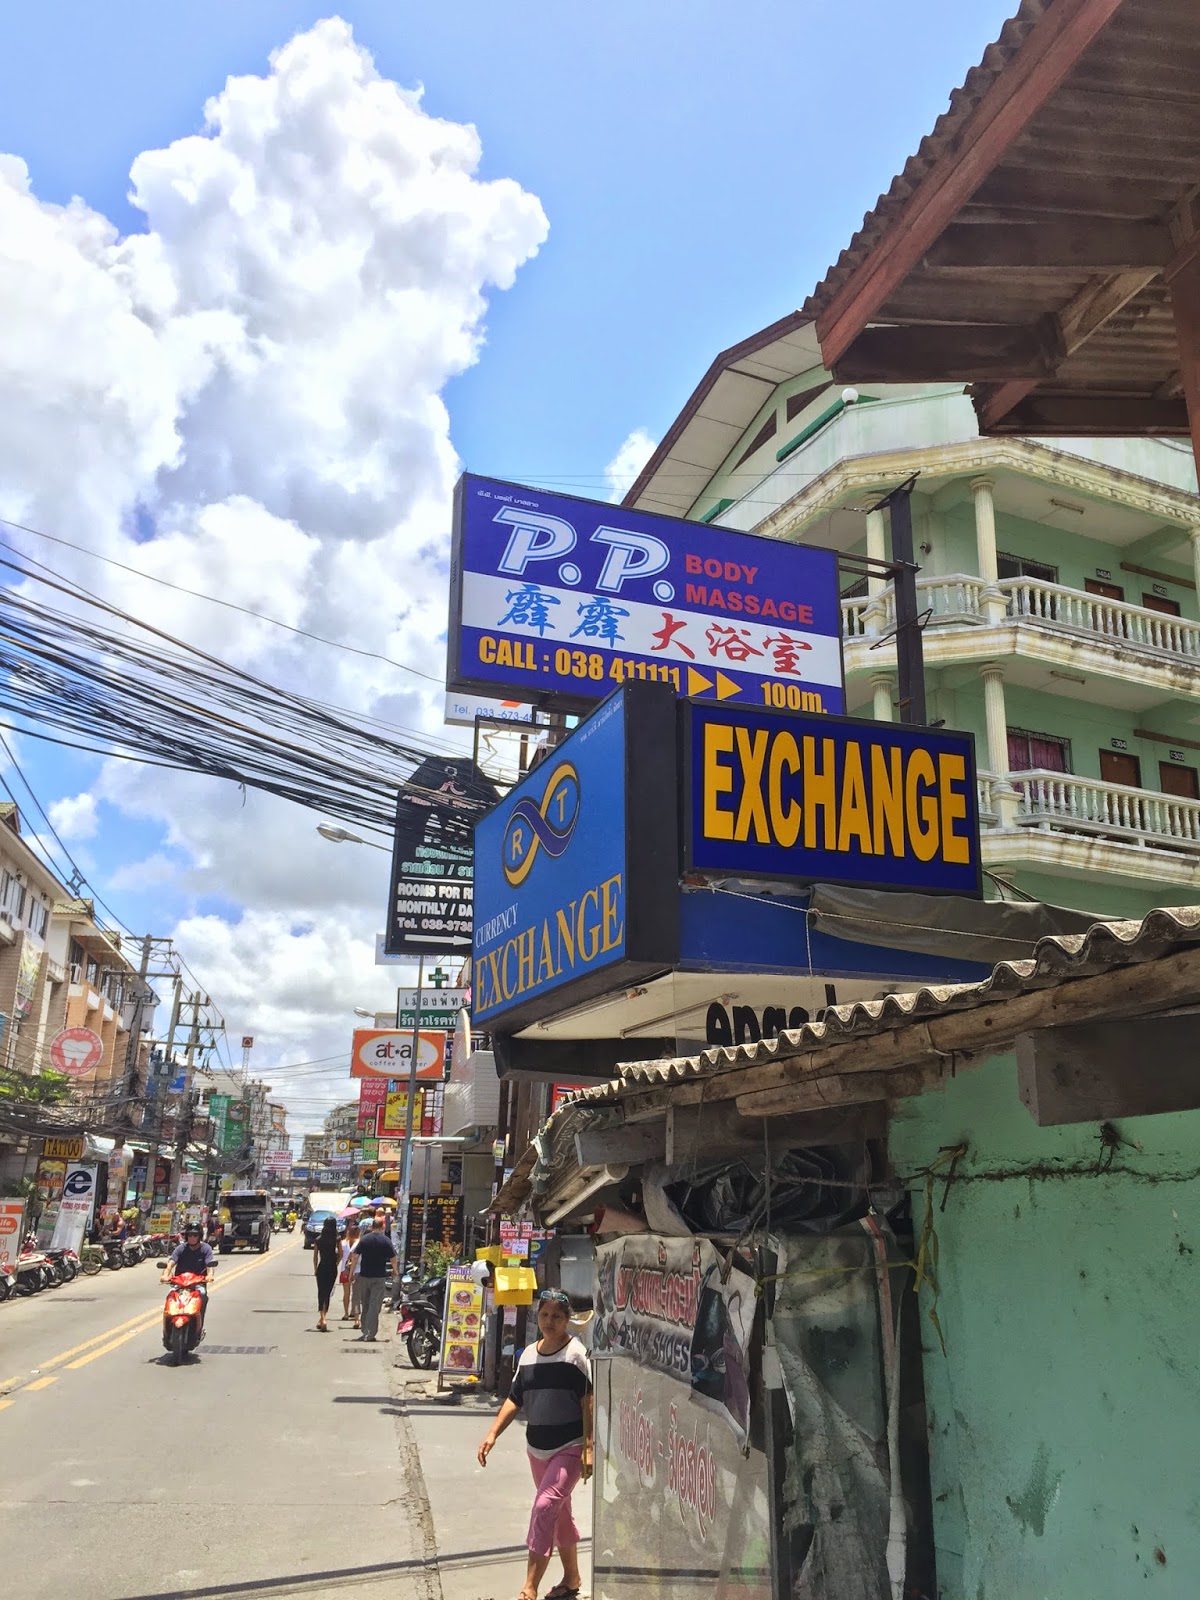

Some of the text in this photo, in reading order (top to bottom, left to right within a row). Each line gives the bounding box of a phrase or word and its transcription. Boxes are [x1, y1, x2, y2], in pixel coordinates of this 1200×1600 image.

[685, 554, 759, 585] BODY
[685, 584, 814, 625] MASSAGE
[479, 636, 537, 672] CALL
[555, 648, 603, 681] 038
[609, 657, 680, 692] 411111
[454, 704, 471, 715] Tel.
[761, 681, 828, 713] 100m.
[556, 787, 568, 823] T
[704, 722, 970, 865] EXCHANGE
[511, 828, 523, 861] R
[397, 882, 436, 898] ROOMS
[438, 885, 460, 899] FOR
[397, 900, 448, 915] MONTHLY
[397, 917, 418, 929] Tel.
[475, 903, 519, 949] CURRENCY
[474, 873, 623, 1015] EXCHANGE
[47, 1138, 80, 1156] TATTOO
[412, 1197, 459, 1205] Beer Beer
[651, 1331, 690, 1373] SHOES
